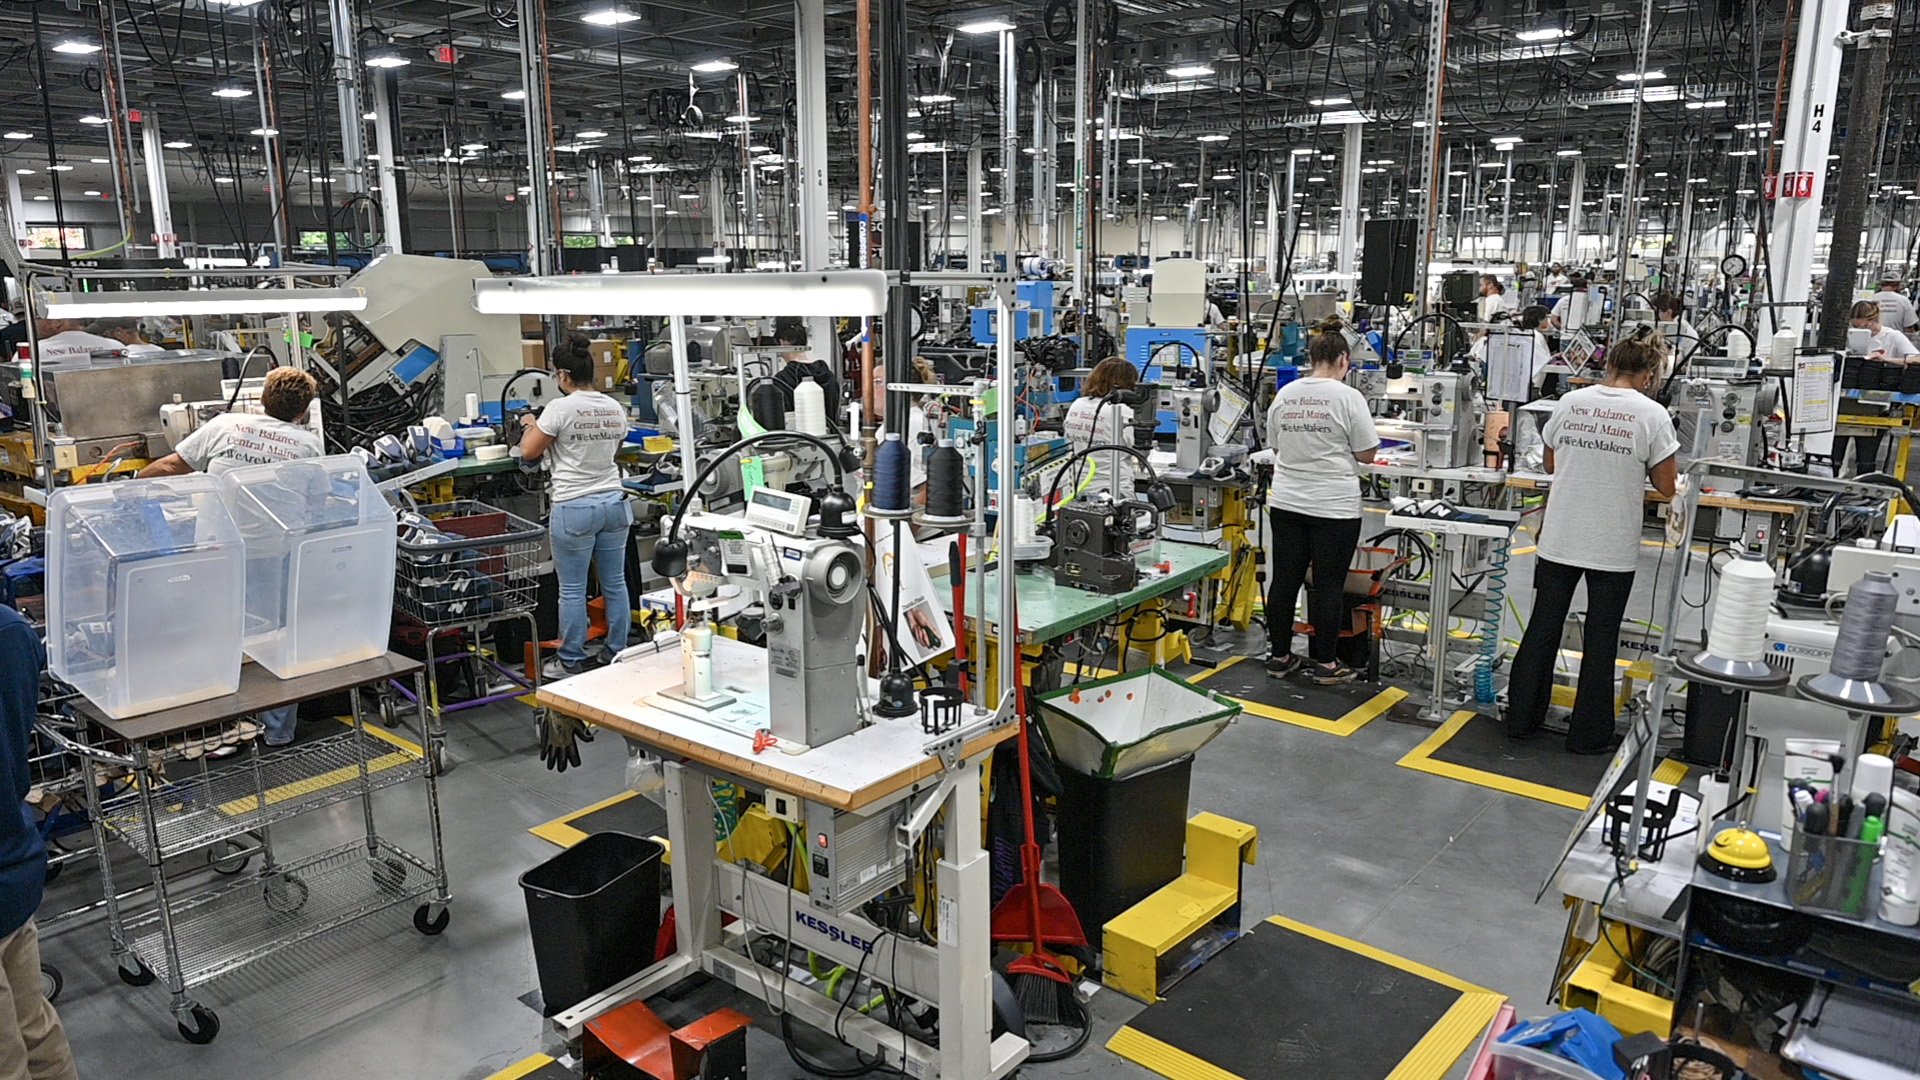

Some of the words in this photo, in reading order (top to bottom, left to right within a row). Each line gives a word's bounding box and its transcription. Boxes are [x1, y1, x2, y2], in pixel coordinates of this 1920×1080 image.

[1813, 104, 1824, 117] H
[1812, 120, 1821, 133] 4
[46, 347, 66, 356] New
[1284, 397, 1297, 406] New
[1299, 396, 1331, 406] Balance
[576, 408, 592, 417] New
[1306, 409, 1331, 420] Maine
[1569, 404, 1591, 416] New
[1593, 407, 1636, 423] Balance
[573, 420, 600, 430] Central
[1563, 419, 1598, 434] Central
[1600, 423, 1634, 439] Maine
[234, 424, 256, 435] New
[259, 428, 300, 447] Balance
[227, 436, 265, 451] Central
[266, 445, 300, 460] Maine
[1559, 434, 1633, 456] #WeAreMakers
[1382, 588, 1430, 602] ESSLER
[795, 910, 874, 955] KESSLER
